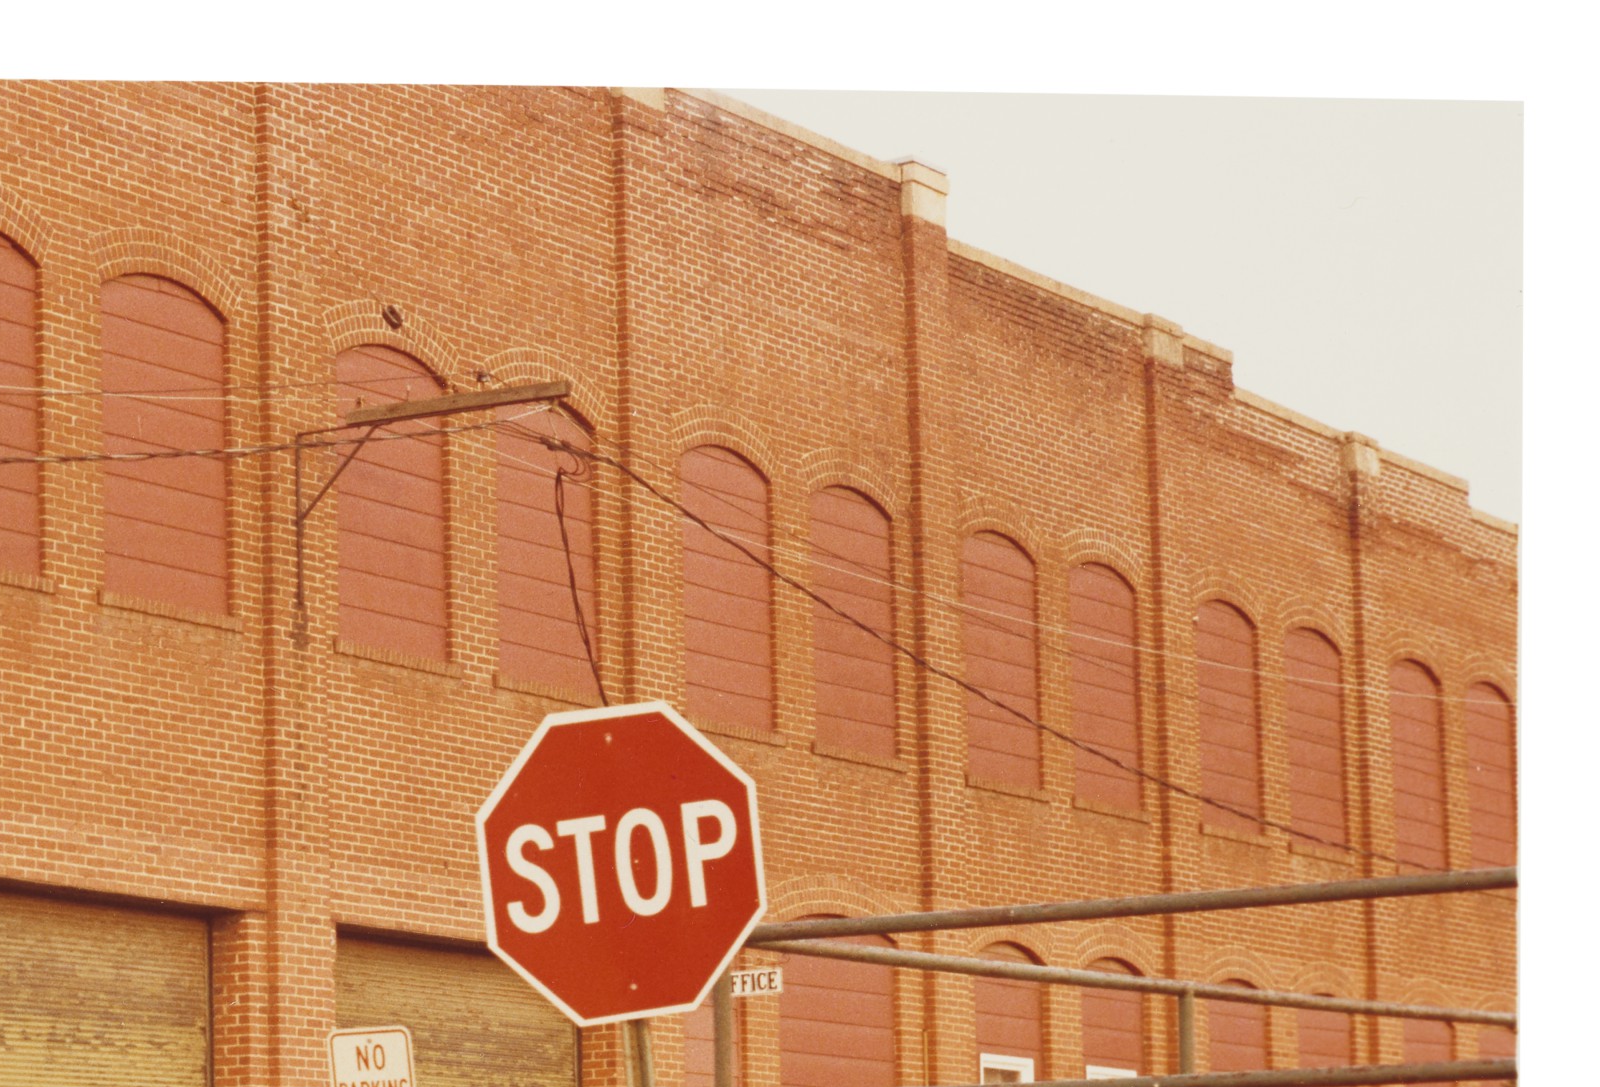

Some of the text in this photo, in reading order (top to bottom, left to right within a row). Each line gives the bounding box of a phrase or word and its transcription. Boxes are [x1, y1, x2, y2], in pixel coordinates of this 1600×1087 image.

[505, 799, 737, 934] STOP
[731, 971, 778, 992] FFICE
[356, 1044, 385, 1071] NO
